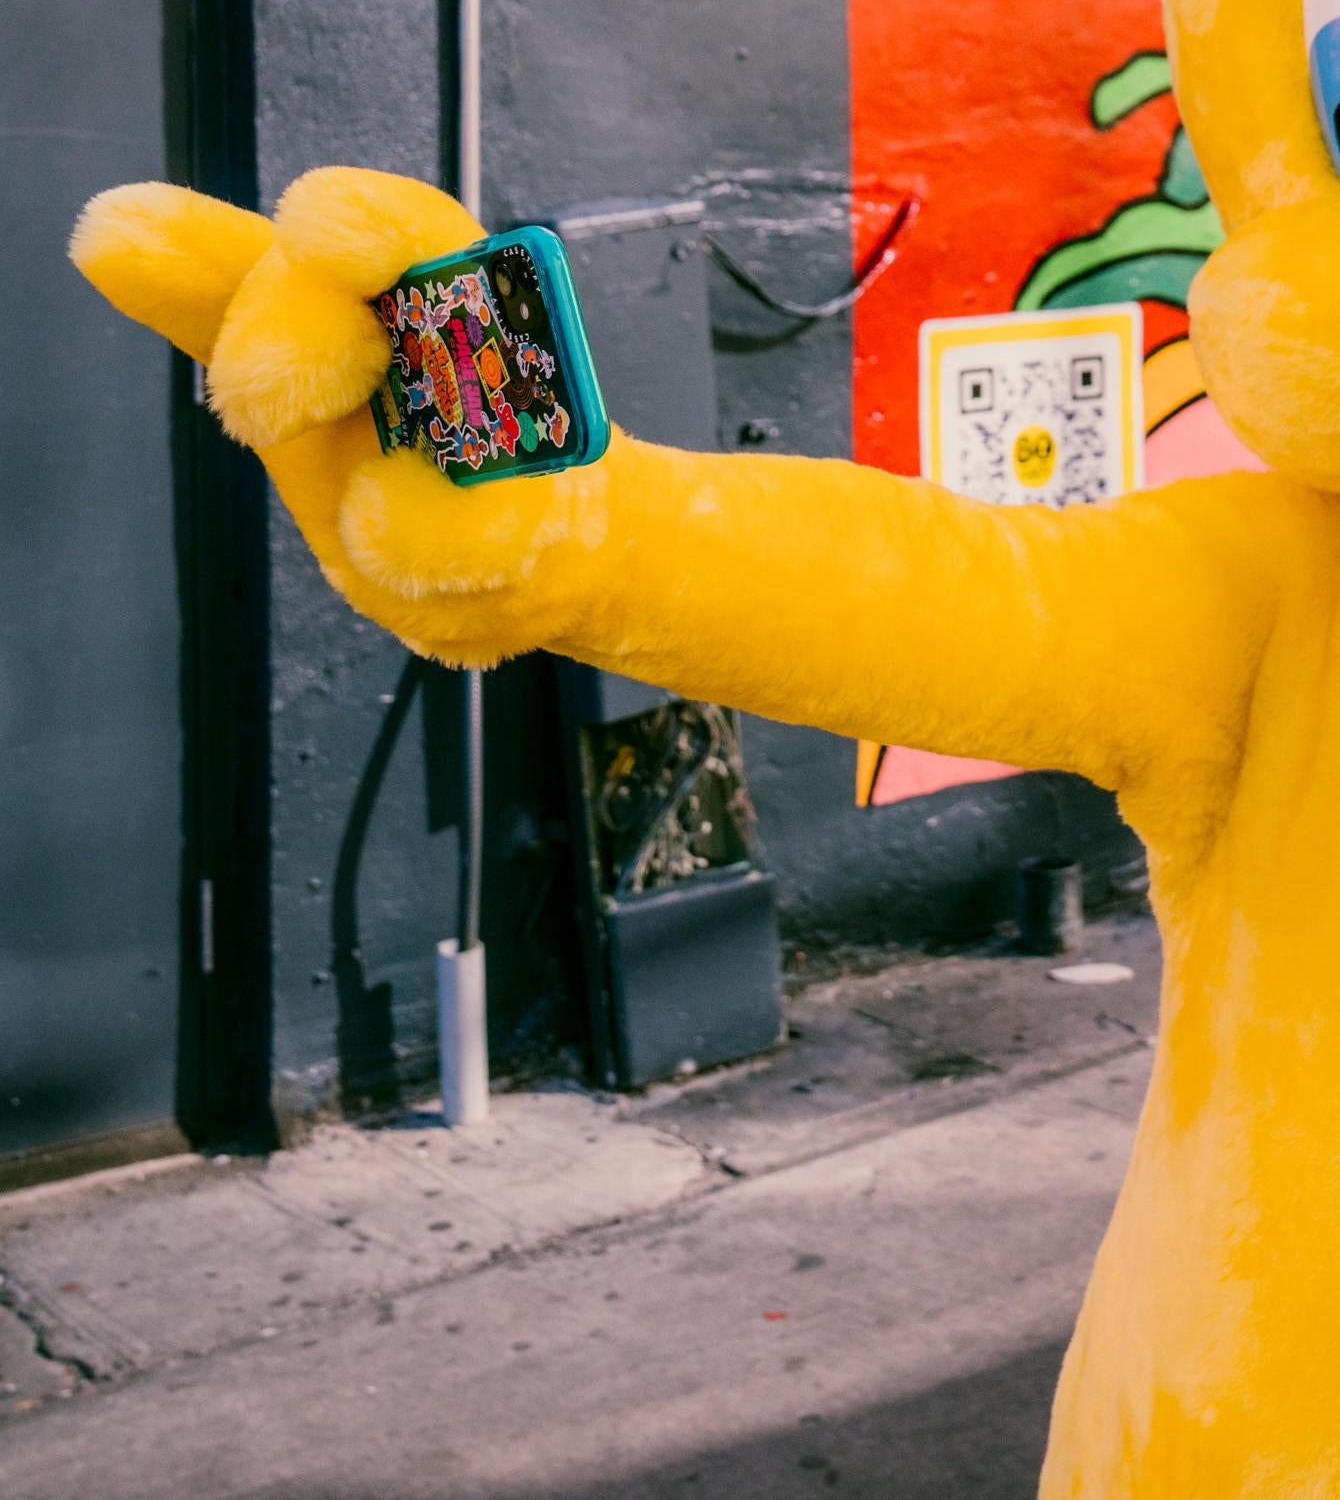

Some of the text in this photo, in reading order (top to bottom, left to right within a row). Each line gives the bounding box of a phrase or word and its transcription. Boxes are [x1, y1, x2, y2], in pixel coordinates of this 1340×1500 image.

[503, 246, 541, 292] CASETIFY
[421, 336, 454, 422] SQUAD
[436, 342, 458, 404] TUNE
[451, 318, 482, 427] SPACE JAM
